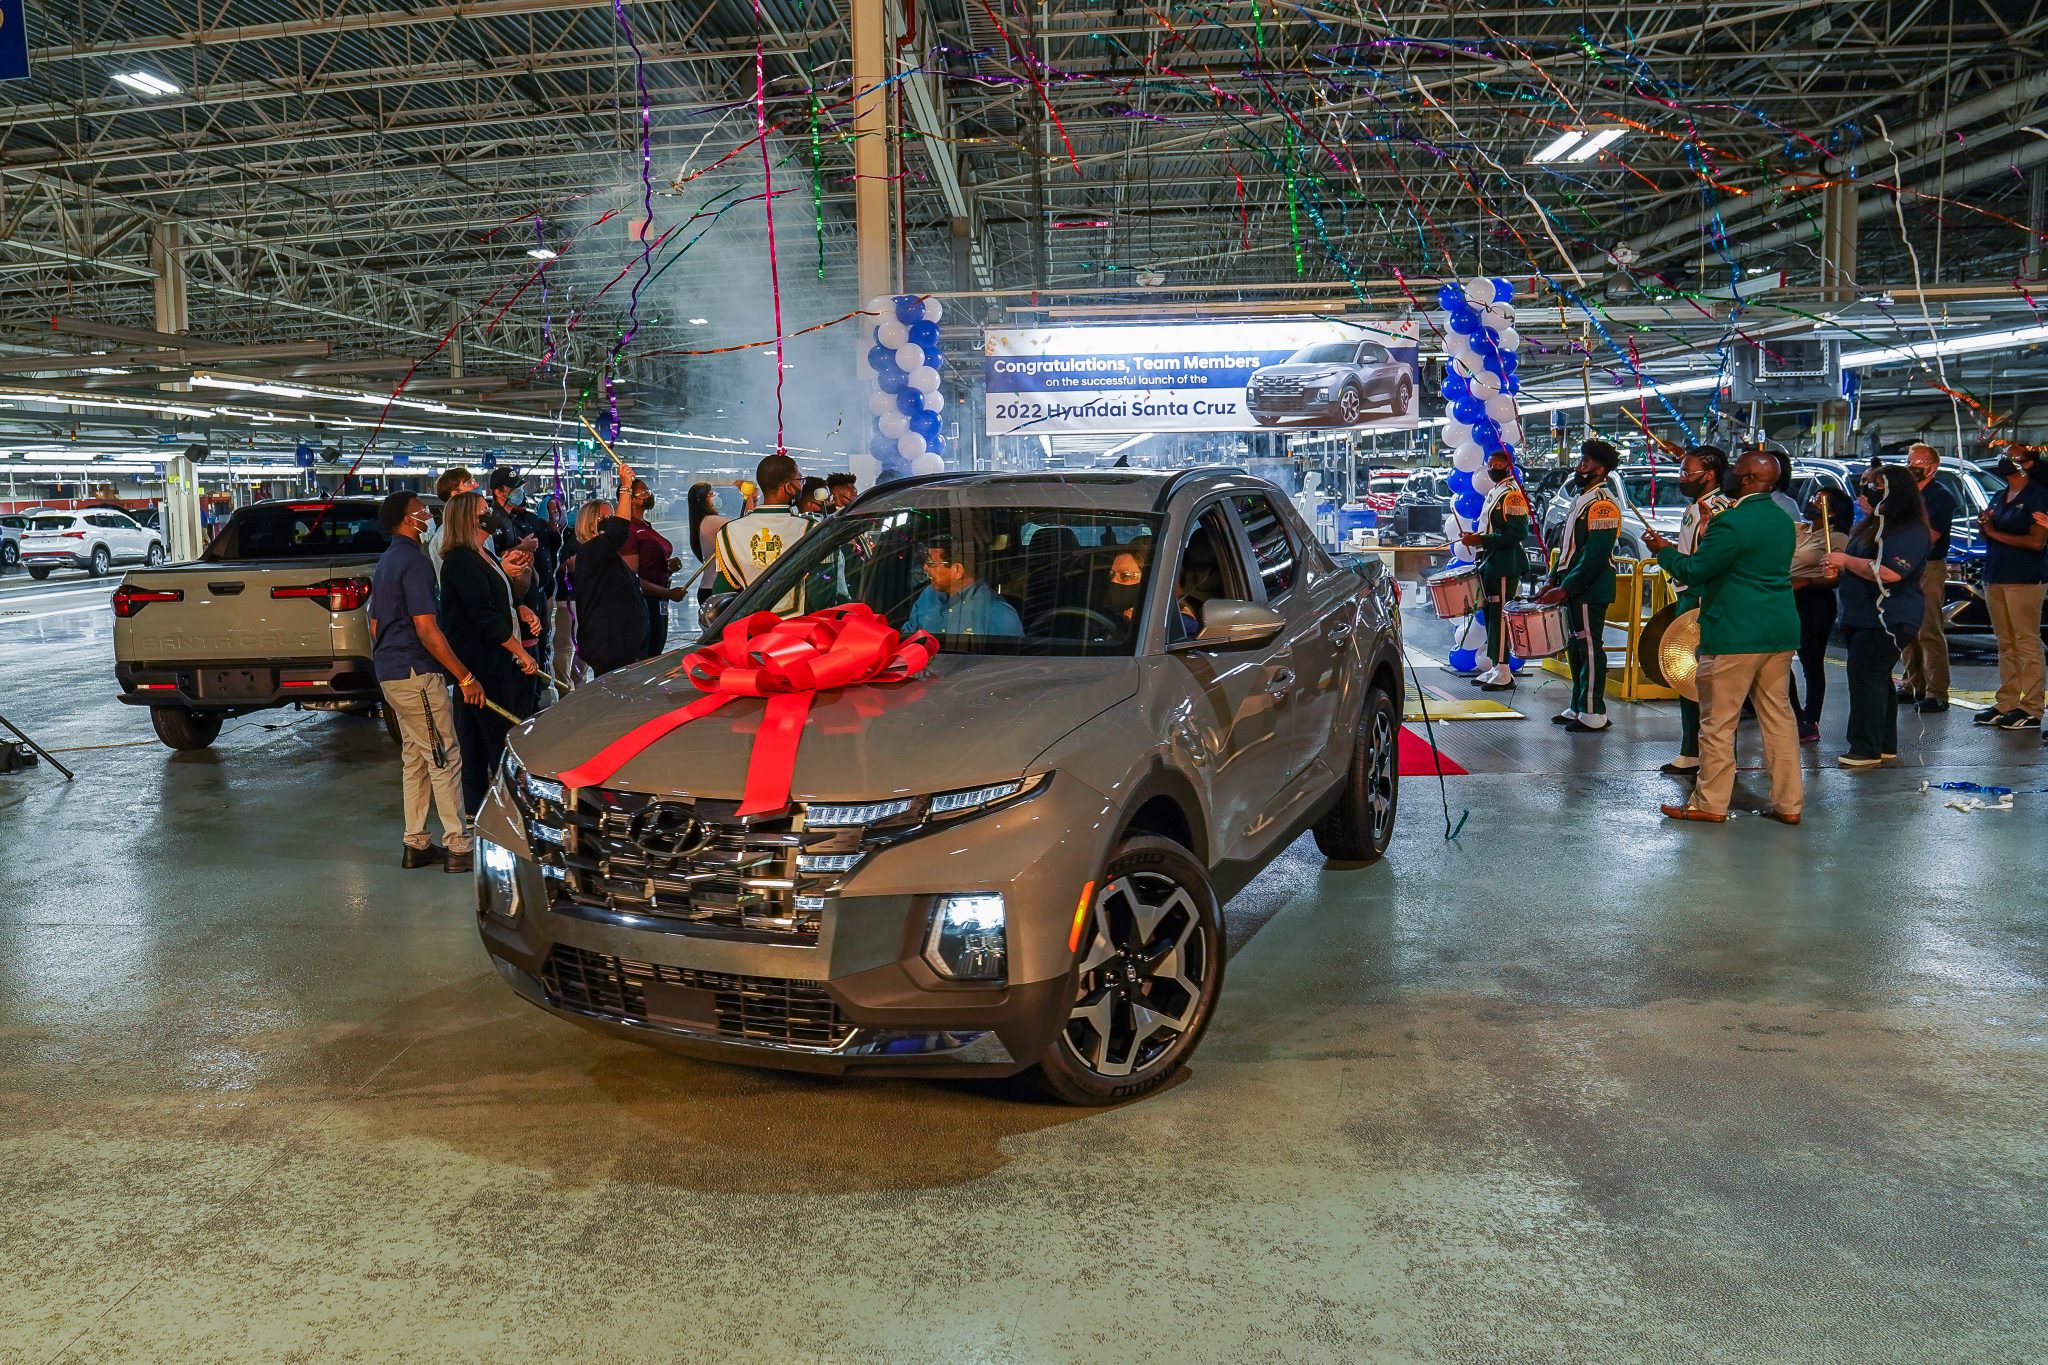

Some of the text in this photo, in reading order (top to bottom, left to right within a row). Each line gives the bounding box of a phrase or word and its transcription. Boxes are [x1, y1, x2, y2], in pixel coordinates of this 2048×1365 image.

[993, 354, 1261, 376] Congratulations, Team Members
[1045, 373, 1208, 387] on the successful launch of the
[995, 400, 1237, 421] 2022 Hyundai Santa Cruz
